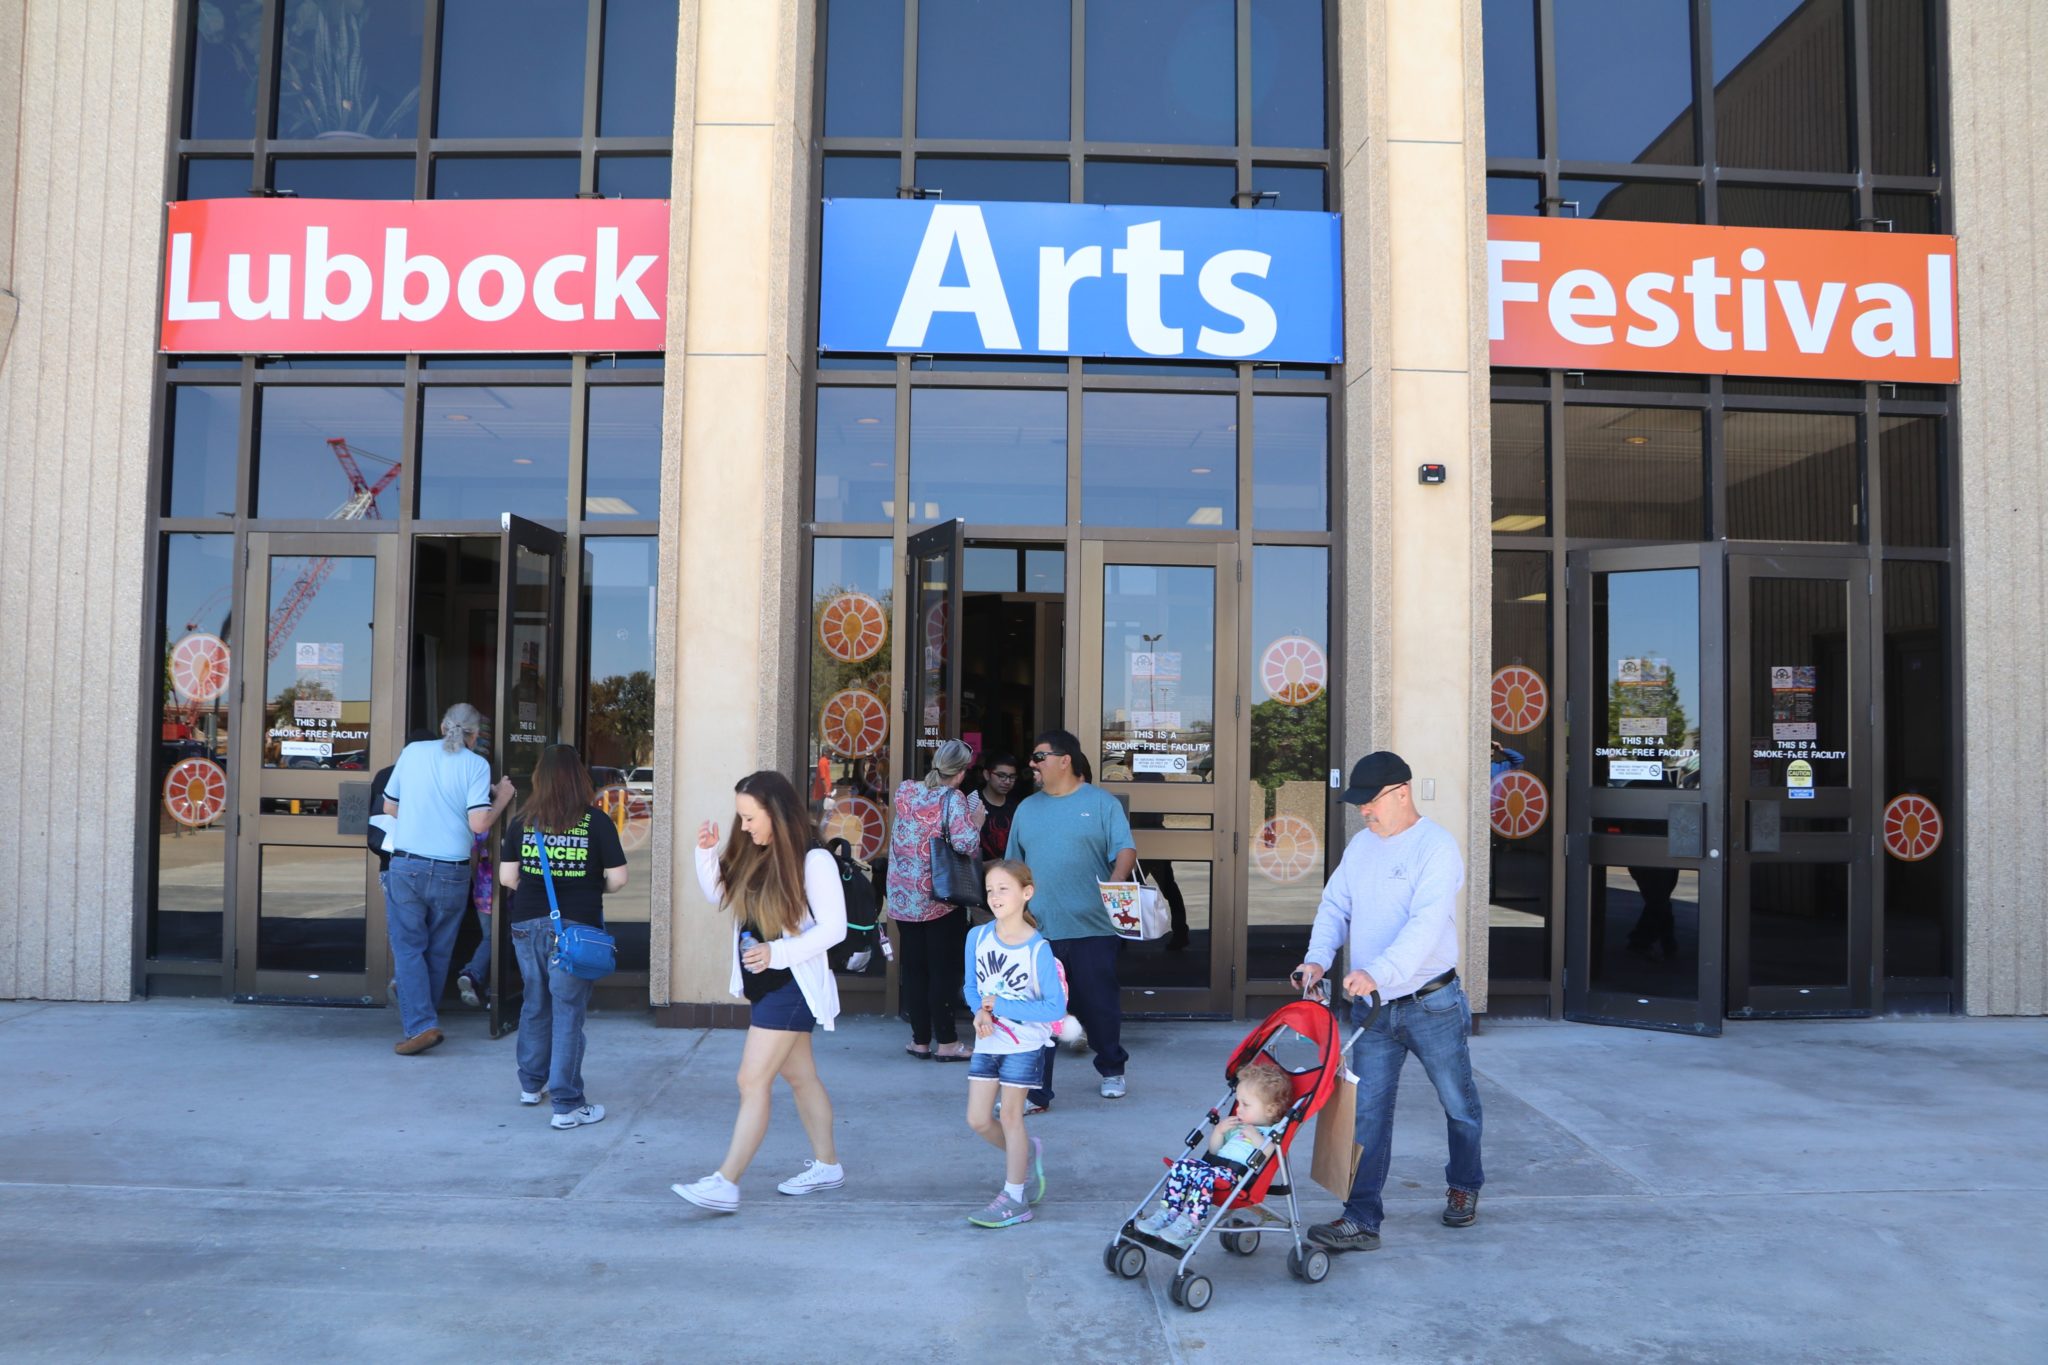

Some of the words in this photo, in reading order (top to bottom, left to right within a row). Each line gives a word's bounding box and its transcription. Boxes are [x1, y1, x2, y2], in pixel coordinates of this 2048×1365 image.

[168, 226, 661, 322] Lubbock
[886, 204, 1278, 357] Arts
[1487, 239, 1953, 359] Festival
[295, 719, 315, 727] THIS
[318, 719, 327, 727] IS
[331, 720, 337, 728] A
[269, 729, 327, 738] SMOKE-FREE
[331, 731, 368, 739] FACILITY
[1134, 730, 1153, 739] THIS
[1157, 731, 1166, 739] IS
[1170, 731, 1177, 739] A
[1622, 737, 1642, 745] THIS
[1645, 737, 1653, 745] IS
[1658, 737, 1664, 745] A
[1777, 741, 1796, 749] THIS
[1799, 741, 1807, 749] IS
[1105, 741, 1167, 750] SMOKE-FREE
[1171, 742, 1210, 751] FACILITY
[1595, 748, 1655, 756] SMOKE-FREE
[1658, 748, 1698, 757] FACILITY
[1811, 751, 1846, 759] FACILITY
[521, 845, 588, 860] DANCER
[531, 867, 563, 876] RAING
